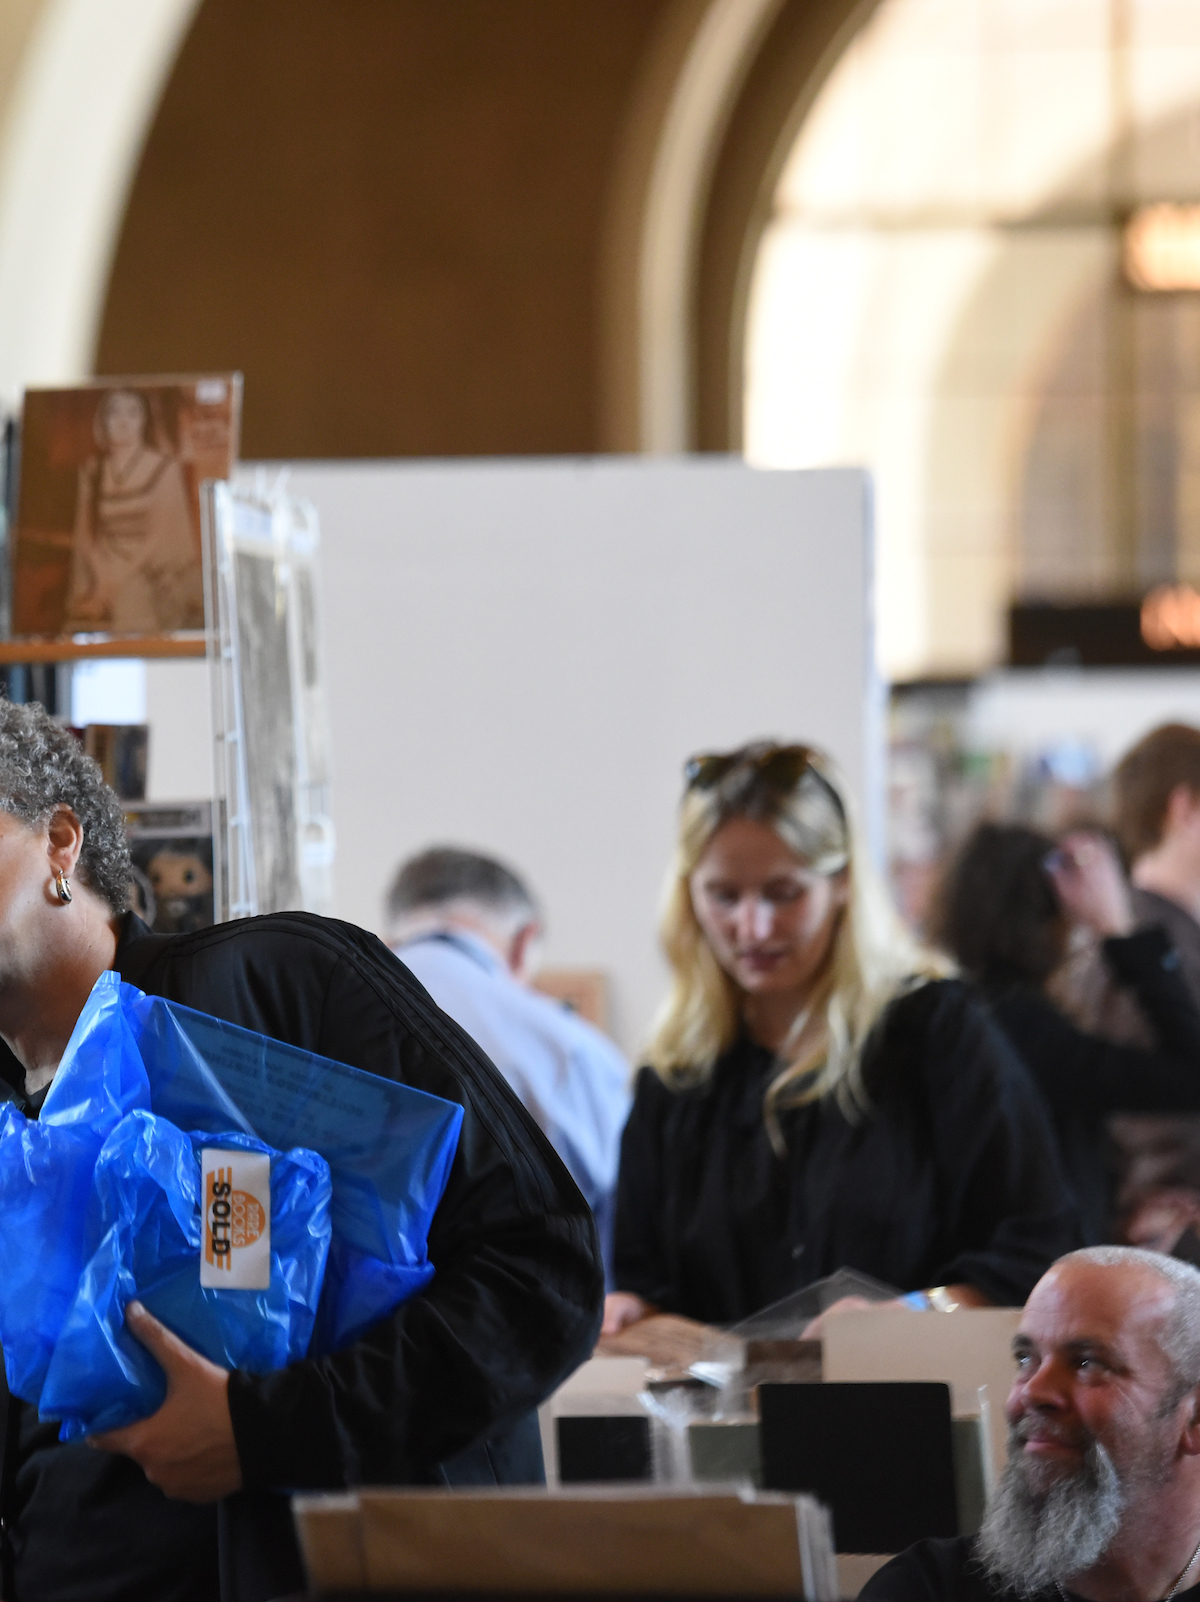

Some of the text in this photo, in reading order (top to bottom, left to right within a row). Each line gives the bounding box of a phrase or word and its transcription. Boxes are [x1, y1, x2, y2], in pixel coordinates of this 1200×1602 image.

[211, 1181, 231, 1256] SOLD
[232, 1193, 246, 1246] BOOKS
[246, 1202, 260, 1238] RARE
